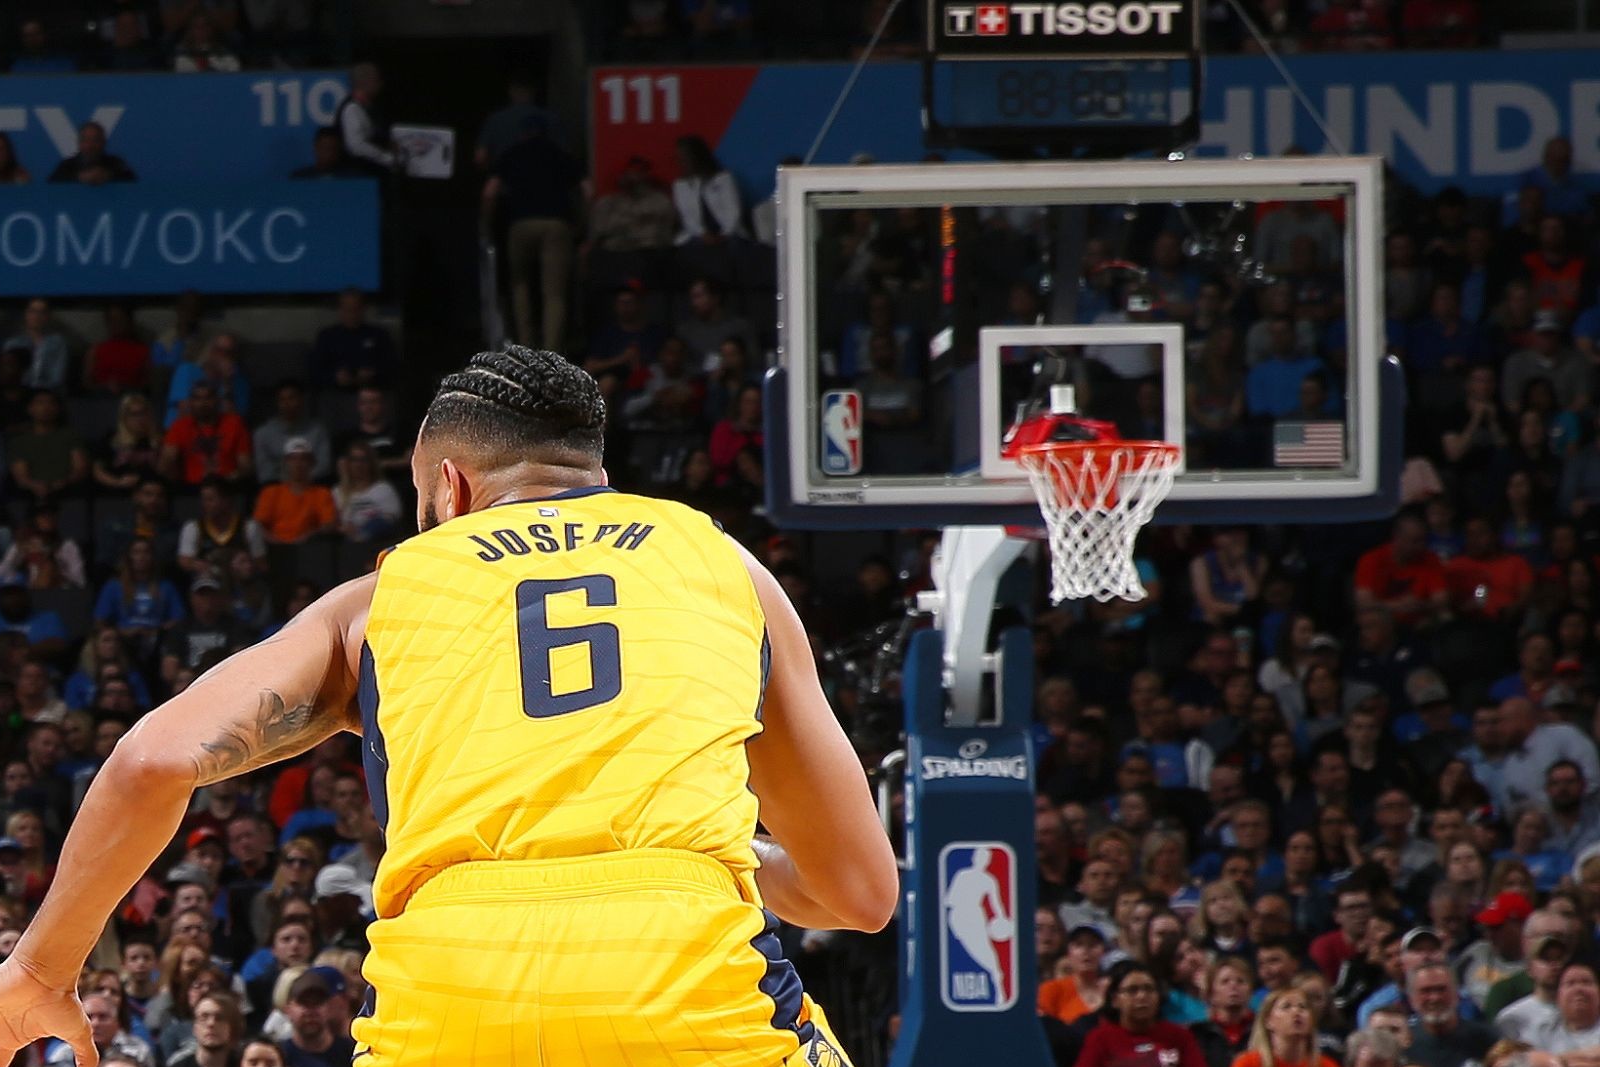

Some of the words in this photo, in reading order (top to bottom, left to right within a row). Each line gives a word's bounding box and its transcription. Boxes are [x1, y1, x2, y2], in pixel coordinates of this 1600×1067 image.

[1011, 3, 1183, 35] TISSOT
[251, 79, 348, 127] 110
[601, 75, 680, 124] 111
[1168, 80, 1600, 177] HUND
[467, 522, 655, 562] JOSEPH
[515, 573, 623, 719] 6
[921, 755, 1027, 781] SPALDING
